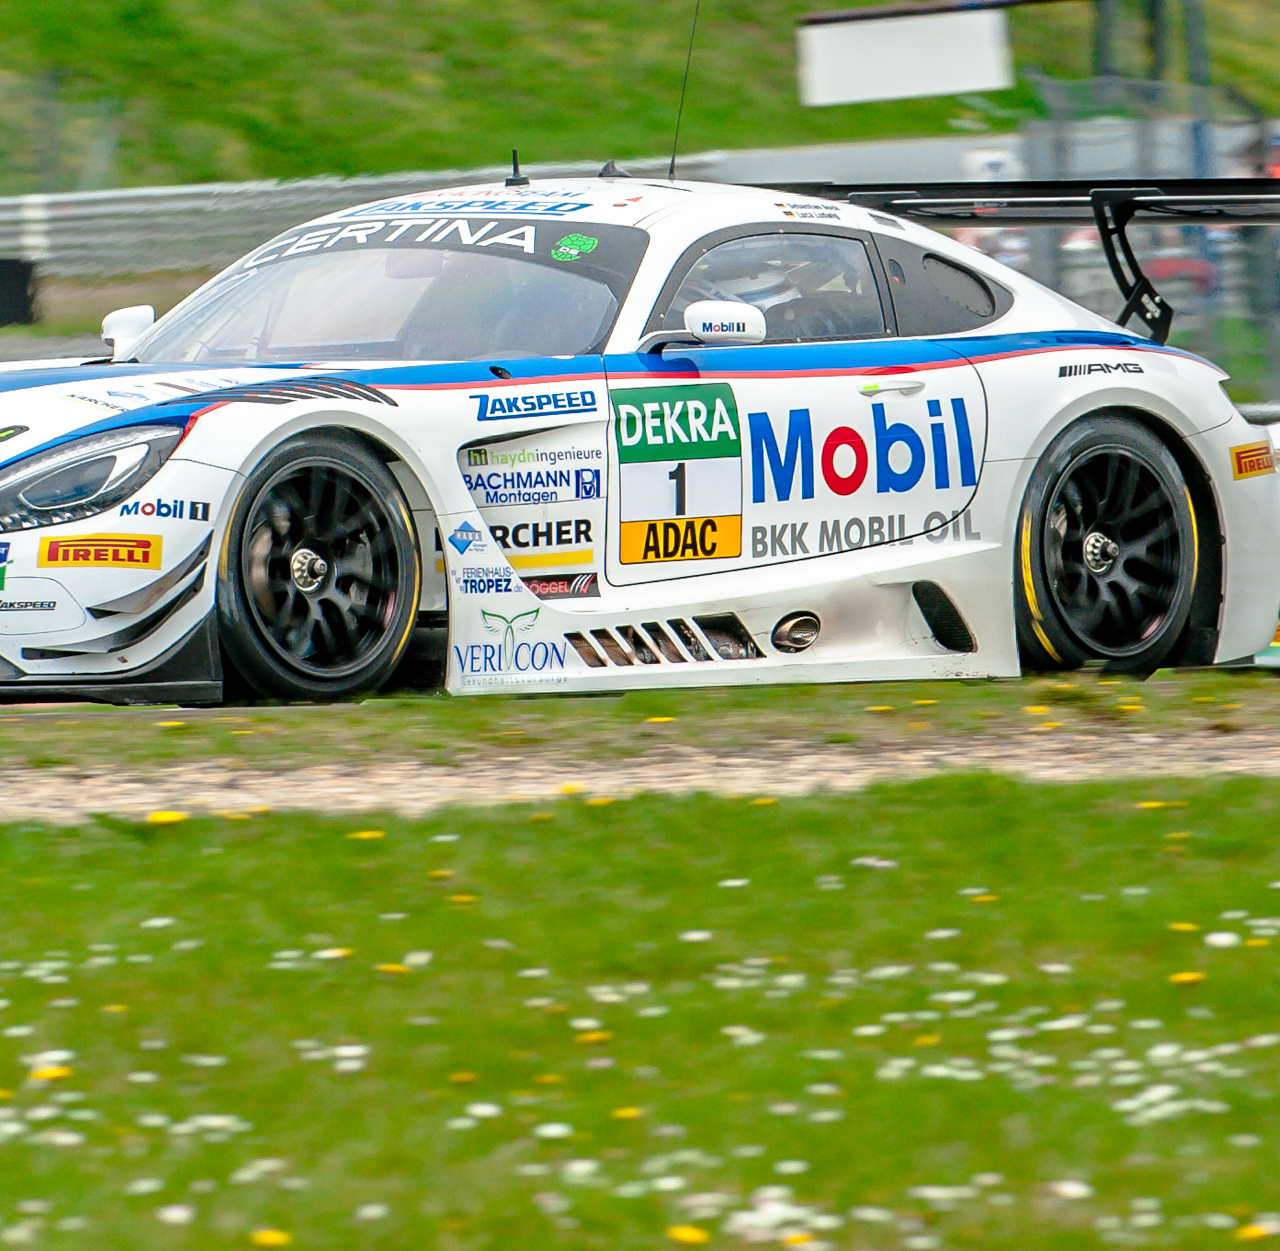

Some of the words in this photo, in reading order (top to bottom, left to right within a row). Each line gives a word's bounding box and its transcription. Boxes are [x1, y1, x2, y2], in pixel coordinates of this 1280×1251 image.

[245, 218, 537, 269] CERTINA
[702, 322, 735, 333] Mobil
[737, 322, 746, 333] 1
[1086, 362, 1145, 375] AMG
[469, 390, 598, 422] ZAKSPEED
[617, 398, 738, 447] DEKRA
[491, 447, 602, 467] haydningenieure
[747, 397, 978, 504] Mobil
[463, 469, 571, 491] BACHMANN
[668, 462, 687, 516] 1
[120, 498, 184, 519] Mobil
[191, 502, 209, 521] 1
[485, 488, 558, 505] Montagen
[642, 518, 718, 560] ADAC
[751, 521, 810, 559] BKK
[819, 513, 916, 552] MOBIL
[923, 508, 981, 543] OIL
[46, 538, 152, 564] PIRELLI
[524, 579, 570, 596] ÖGGEL
